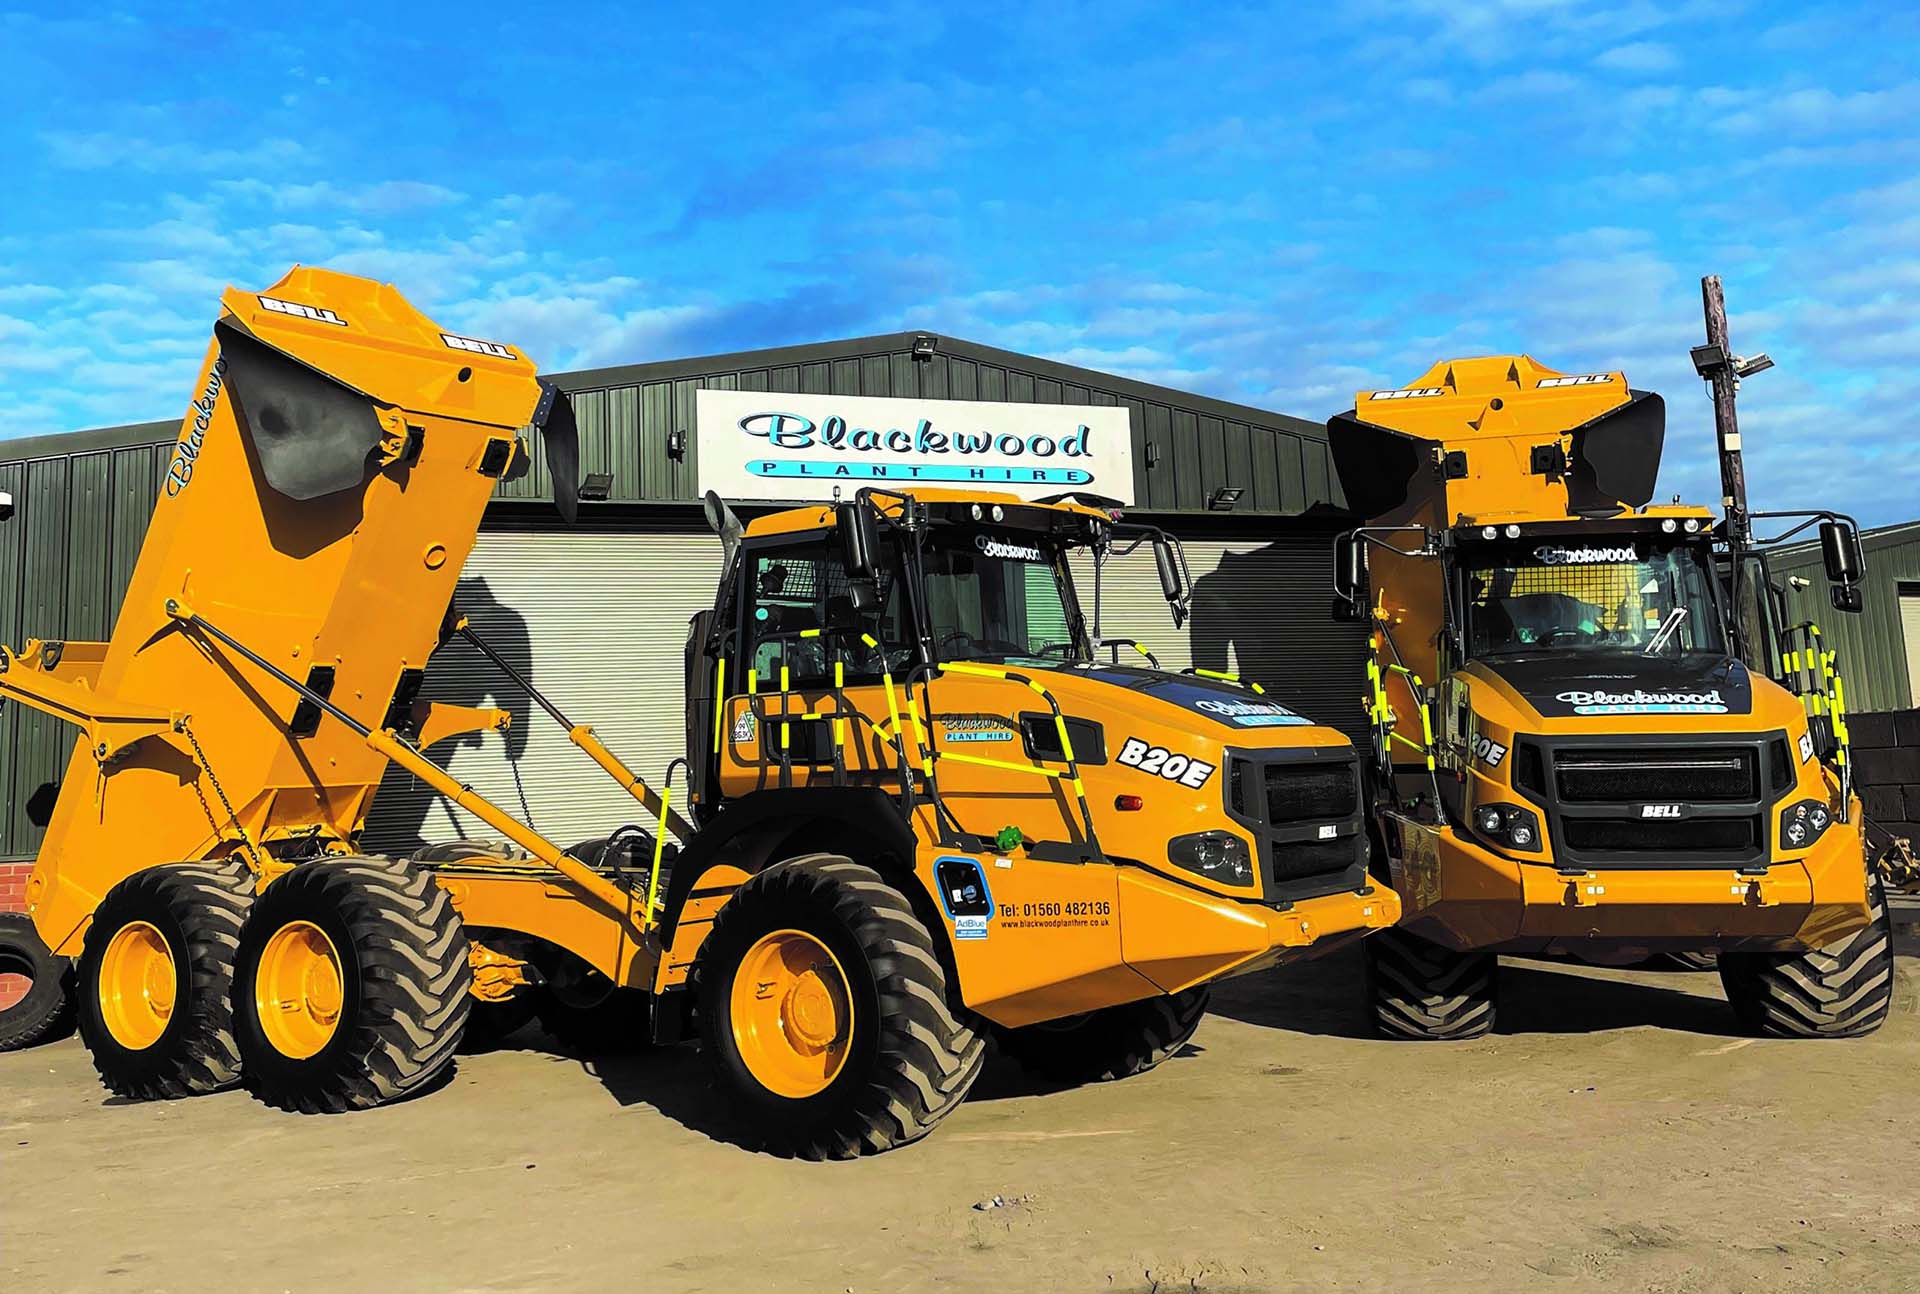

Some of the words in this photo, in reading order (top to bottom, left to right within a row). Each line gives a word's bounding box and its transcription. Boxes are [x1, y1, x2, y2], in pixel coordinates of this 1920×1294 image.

[258, 296, 348, 326] BELL
[440, 334, 517, 360] BELL
[737, 411, 1094, 457] Blackwood
[763, 462, 922, 478] PLANT
[970, 468, 1082, 483] HIRE
[1556, 690, 1725, 705] Blackwood
[986, 732, 1010, 740] HIRE
[1116, 738, 1216, 788] B20E
[1641, 805, 1681, 818] BELL
[999, 904, 1020, 917] Tel:
[1024, 903, 1061, 917] 01560
[1065, 902, 1111, 915] 482136
[956, 918, 986, 929] AdBlue
